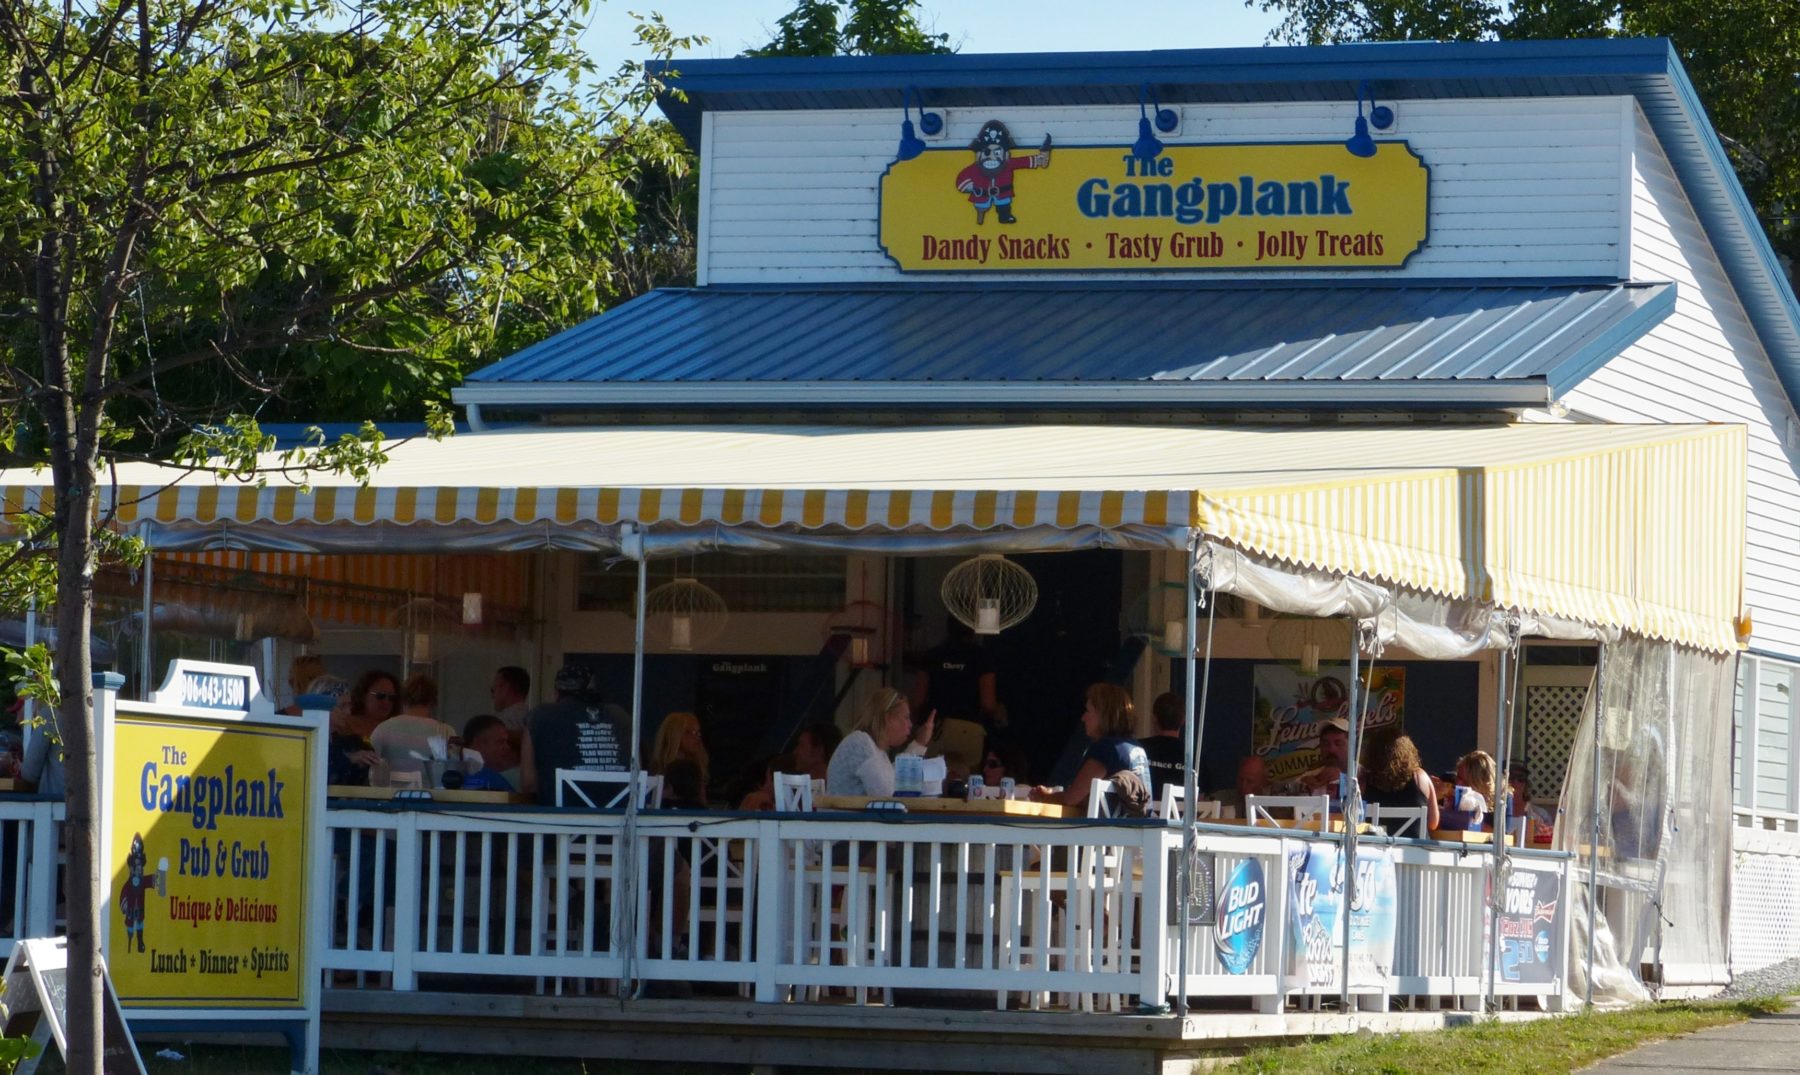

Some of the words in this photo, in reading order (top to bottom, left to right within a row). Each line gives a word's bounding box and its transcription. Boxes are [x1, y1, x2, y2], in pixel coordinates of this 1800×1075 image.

[1122, 155, 1174, 177] The
[1076, 174, 1353, 224] Gangplank
[922, 235, 990, 264] Dandy
[998, 234, 1070, 260] Snacks
[1106, 232, 1162, 262] Tasty
[1169, 231, 1224, 258] Grub
[1255, 230, 1308, 261] Jolly
[1315, 229, 1384, 257] Treats
[181, 674, 245, 706] 906-643-1500
[161, 745, 188, 766] The
[1267, 753, 1322, 779] SUMME
[140, 760, 286, 831] Gangplank
[179, 837, 211, 879] Pub
[216, 840, 227, 878] &
[231, 840, 269, 880] Grub
[169, 896, 211, 928] Unique
[215, 899, 224, 922] &
[226, 897, 277, 923] Delicious
[1227, 881, 1259, 913] BUD
[1221, 903, 1263, 939] LIGHT
[150, 949, 188, 974] Lunch
[199, 951, 239, 975] Dinner
[250, 947, 289, 978] Spirits
